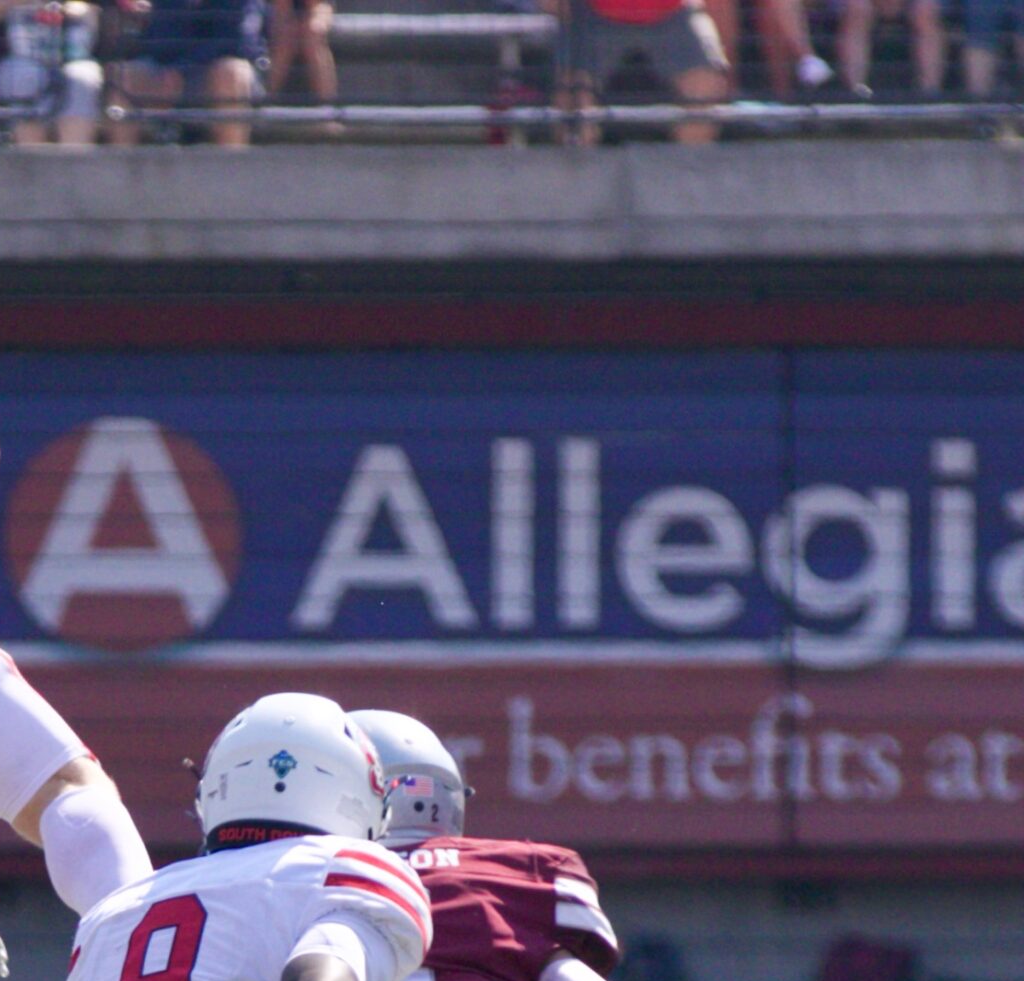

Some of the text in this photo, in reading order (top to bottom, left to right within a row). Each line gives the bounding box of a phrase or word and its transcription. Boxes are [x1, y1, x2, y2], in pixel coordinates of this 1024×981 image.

[508, 695, 904, 803] benefits
[431, 803, 439, 822] 2
[218, 826, 266, 842] SOUTH
